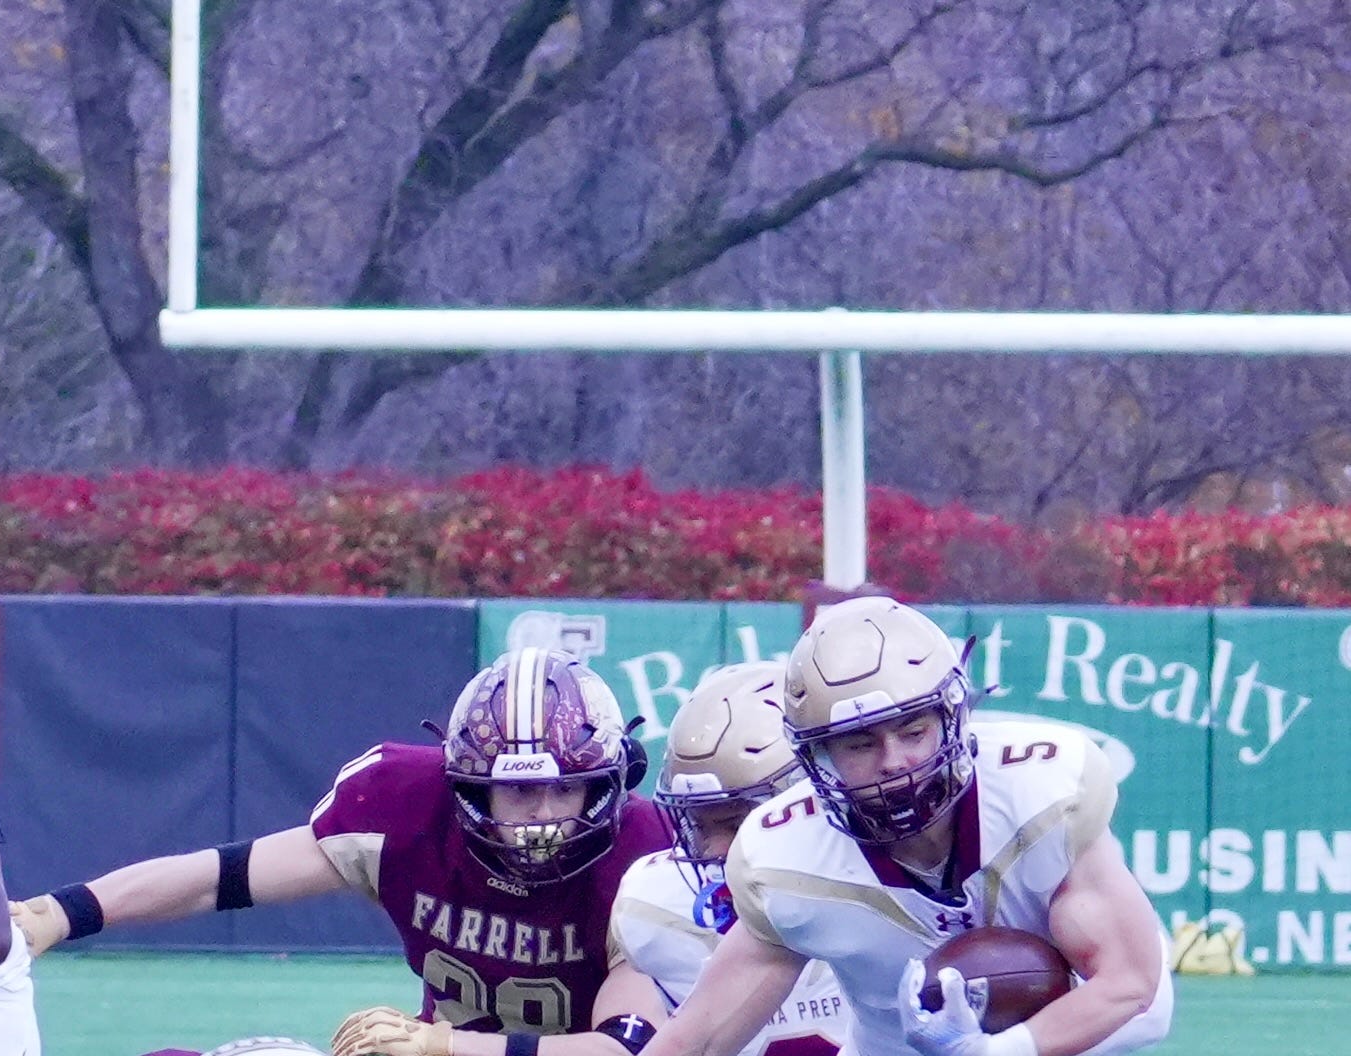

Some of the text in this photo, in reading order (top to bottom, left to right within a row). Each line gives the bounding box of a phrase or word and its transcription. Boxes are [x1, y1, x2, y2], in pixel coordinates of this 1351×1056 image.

[1036, 615, 1312, 764] Realty
[502, 760, 545, 772] LIONS
[1001, 741, 1058, 766] 5
[761, 796, 817, 829] 5
[411, 890, 584, 966] FARRELL
[797, 996, 842, 1020] PREP
